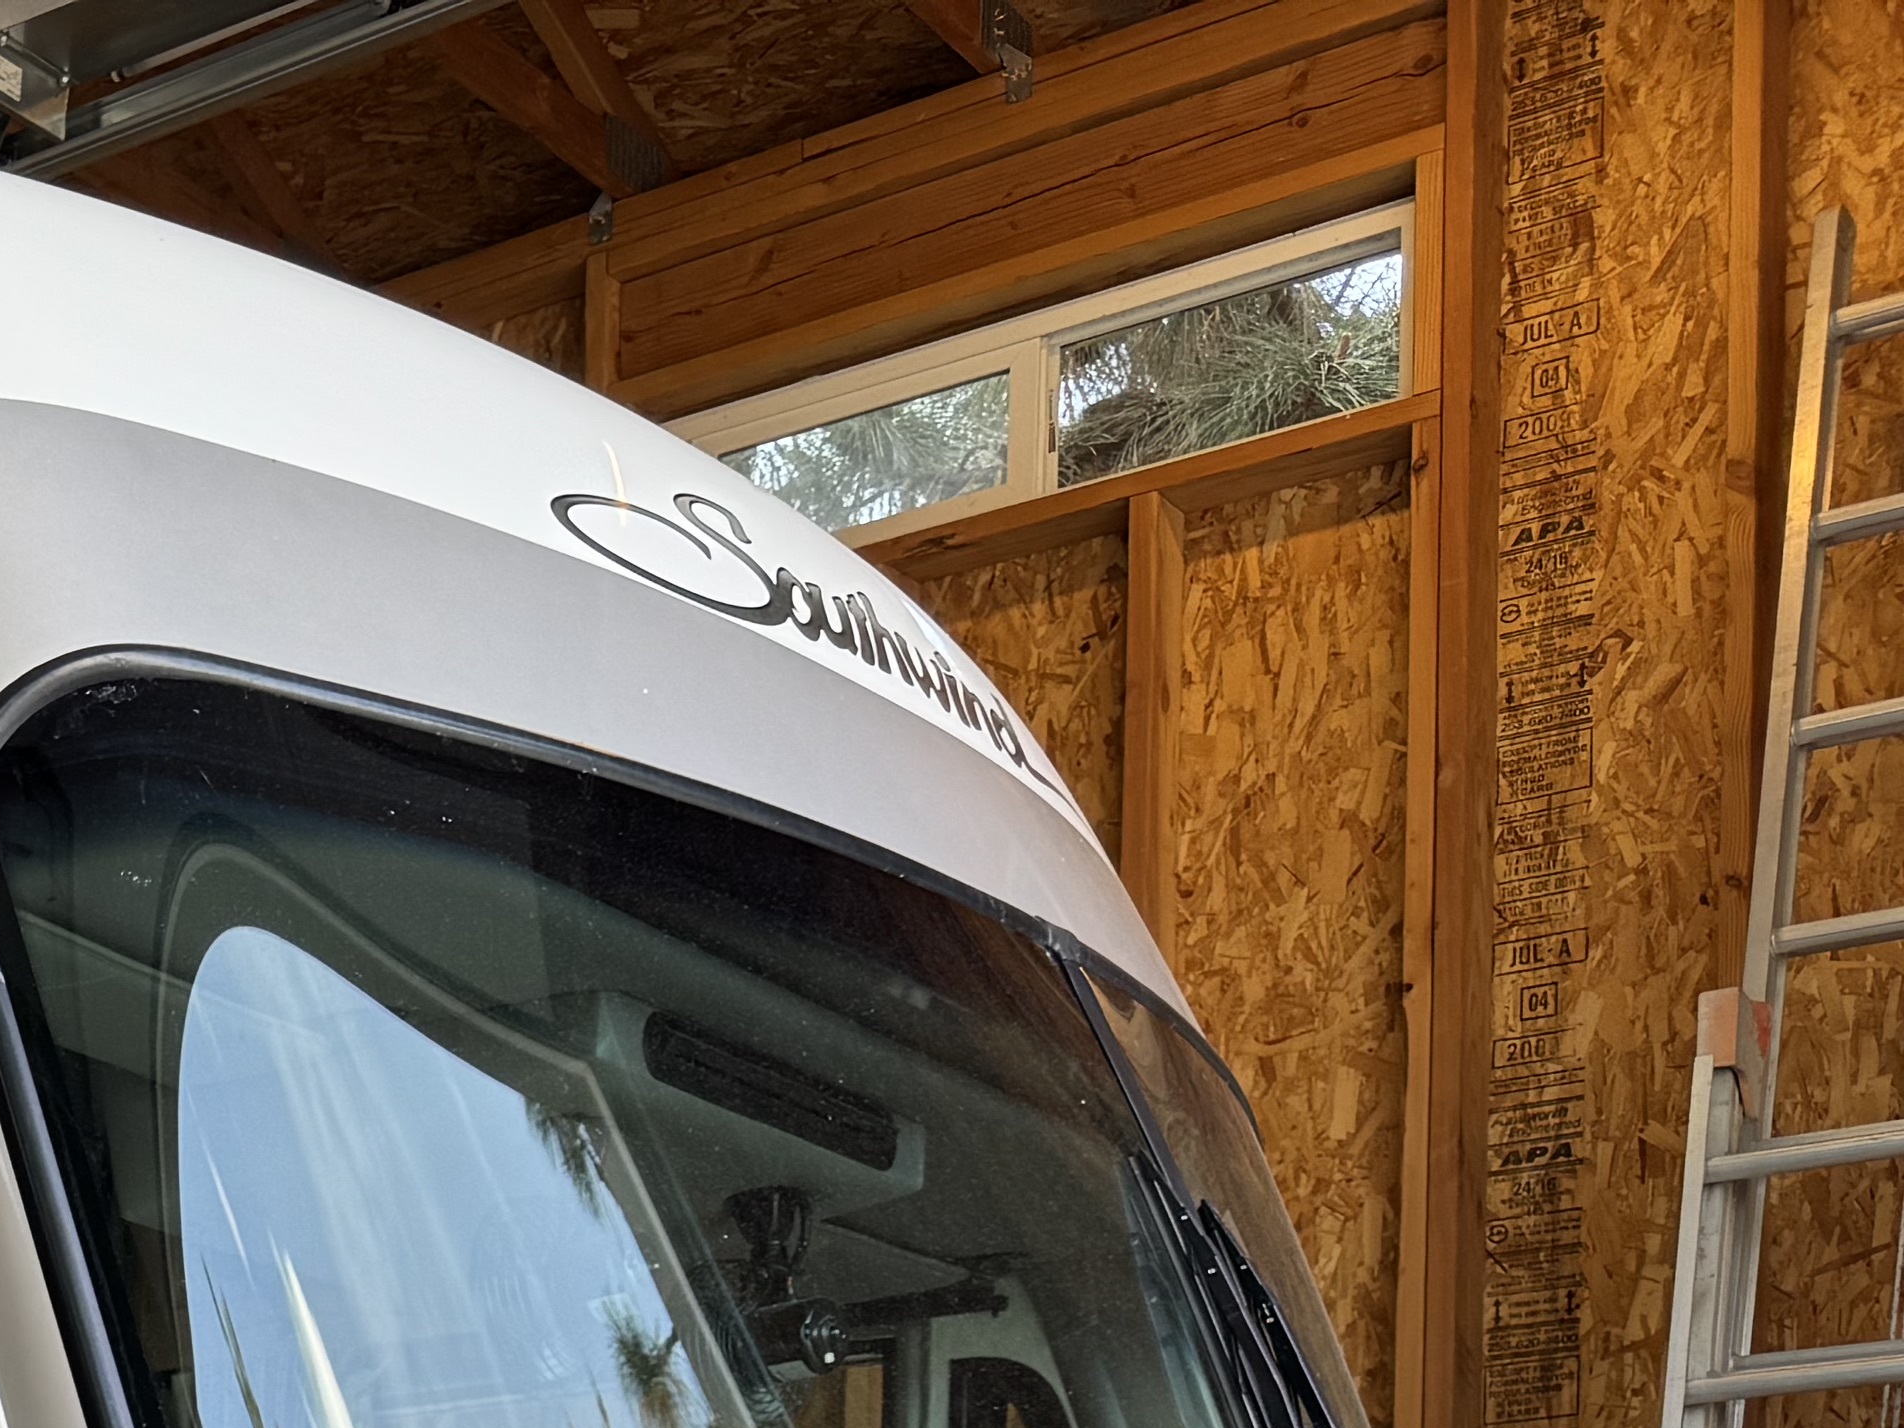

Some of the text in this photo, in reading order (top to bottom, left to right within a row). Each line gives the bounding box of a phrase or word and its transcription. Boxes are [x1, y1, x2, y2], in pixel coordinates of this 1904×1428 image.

[1539, 364, 1560, 389] 04
[1510, 514, 1586, 547] APA
[549, 492, 1082, 830] Southwind
[1528, 990, 1549, 1012] 04
[1498, 1141, 1573, 1168] APA
